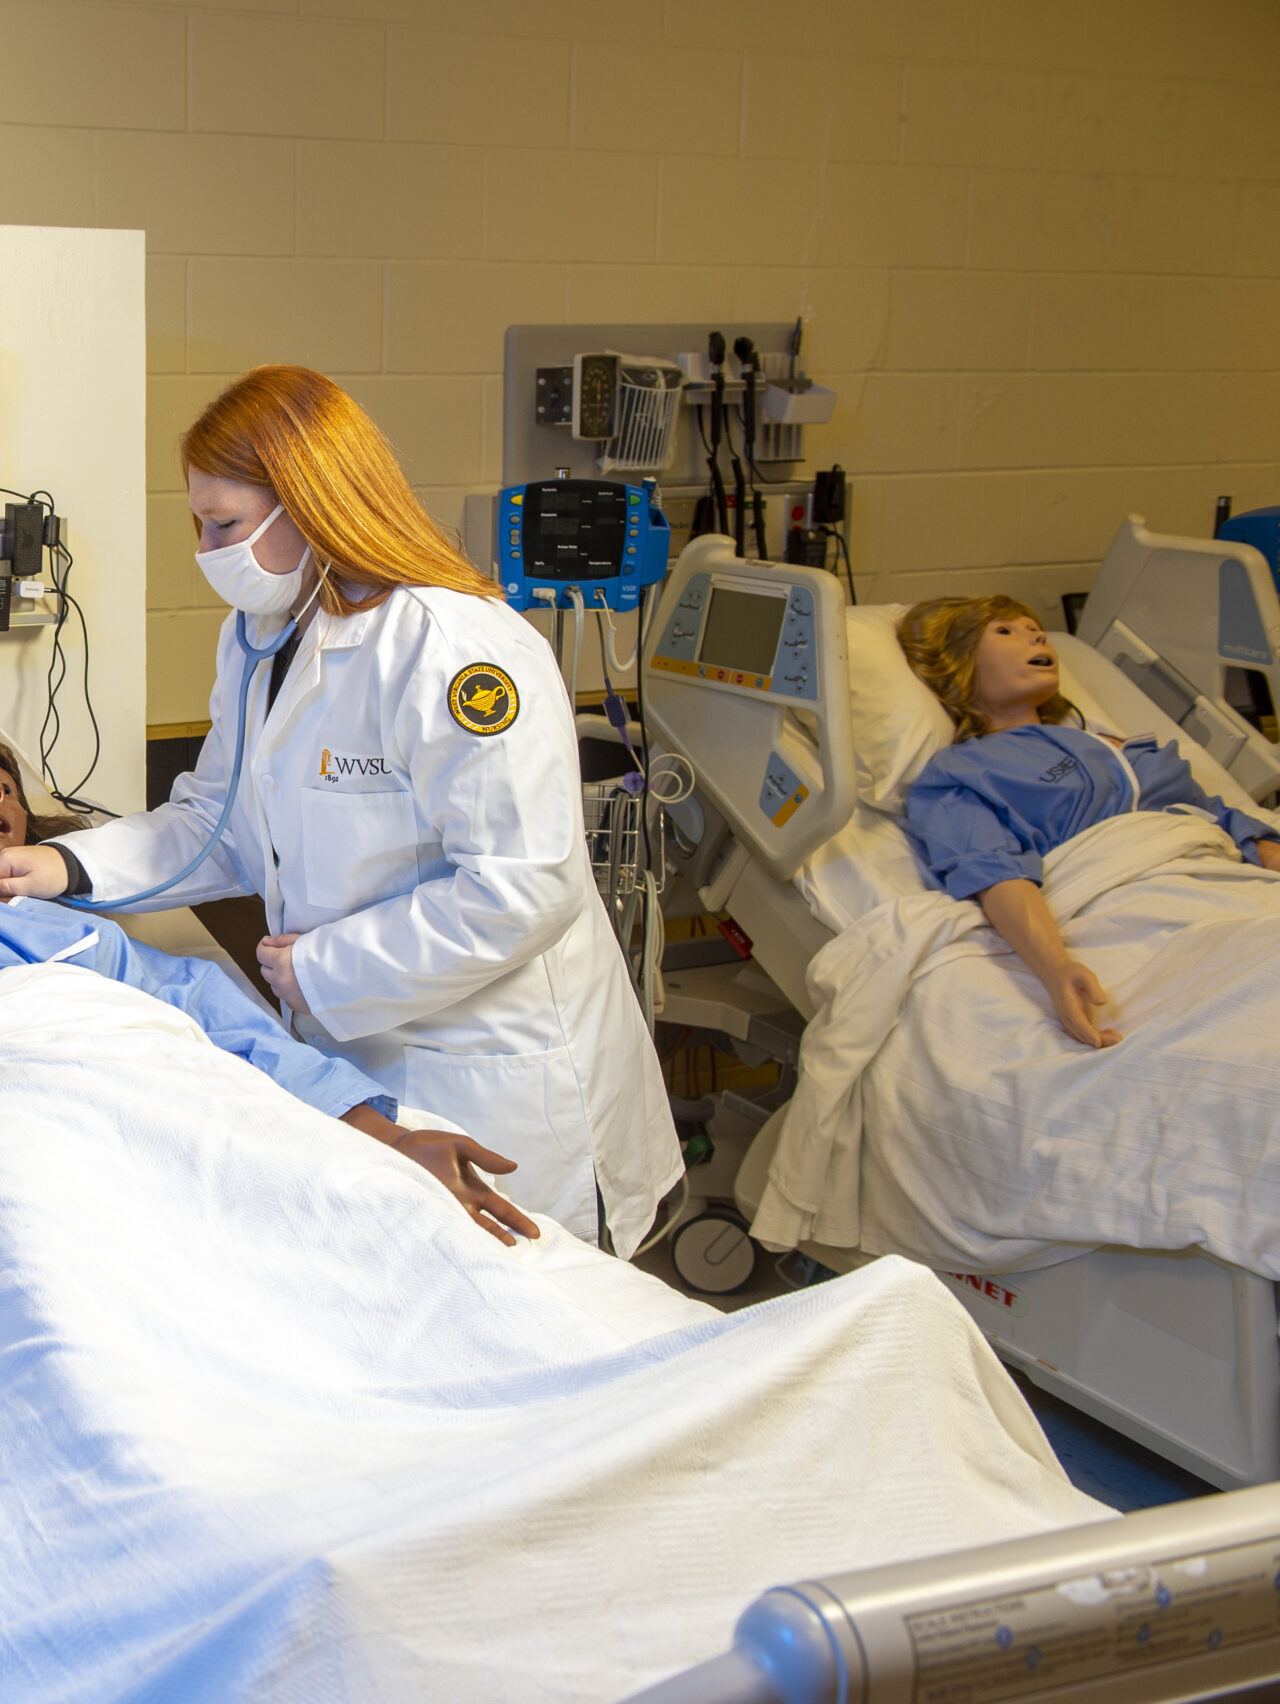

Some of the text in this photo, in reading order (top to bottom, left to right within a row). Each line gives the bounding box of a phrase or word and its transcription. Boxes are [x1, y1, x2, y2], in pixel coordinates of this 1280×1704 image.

[452, 666, 513, 715] WEST VIRGINIA STATE UNIVERSITY
[481, 717, 511, 732] NURSING
